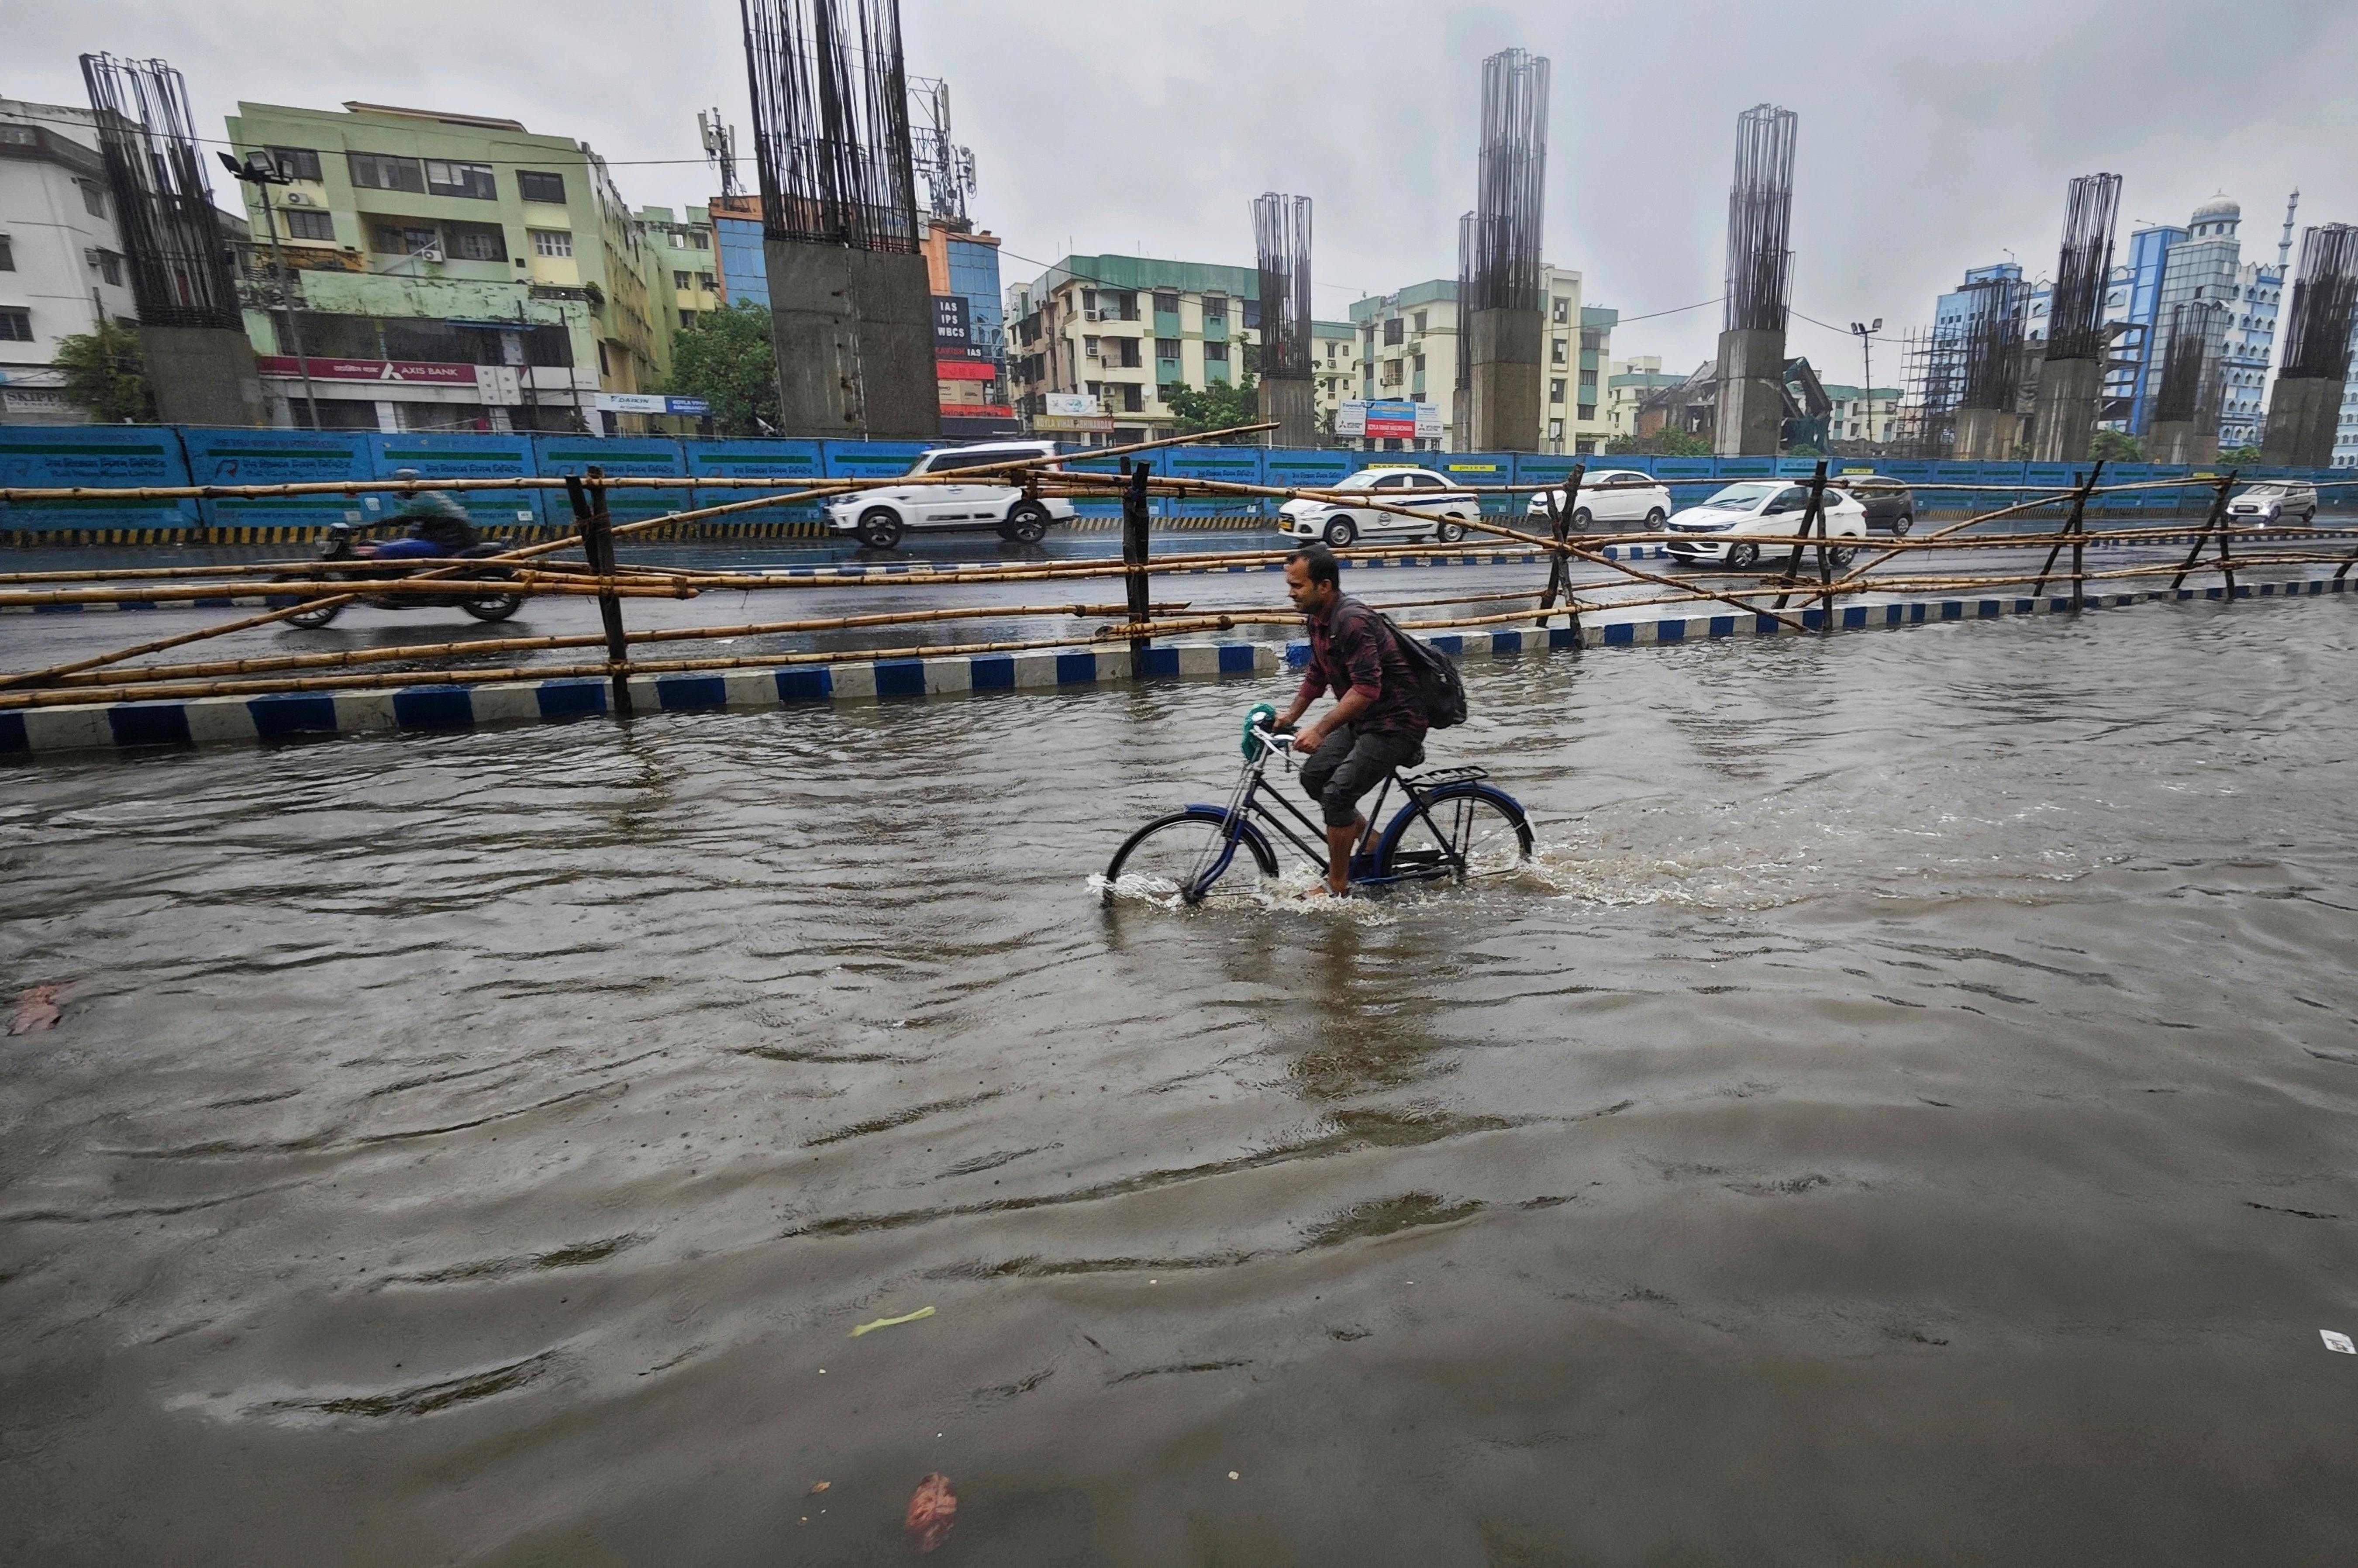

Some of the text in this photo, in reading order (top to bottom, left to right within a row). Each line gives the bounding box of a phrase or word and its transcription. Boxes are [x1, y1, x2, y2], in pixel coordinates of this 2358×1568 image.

[940, 301, 957, 311] IAS
[941, 314, 958, 324] IPS
[938, 327, 965, 338] WBCS
[967, 348, 981, 357] IAS
[7, 392, 66, 402] SKIPPE
